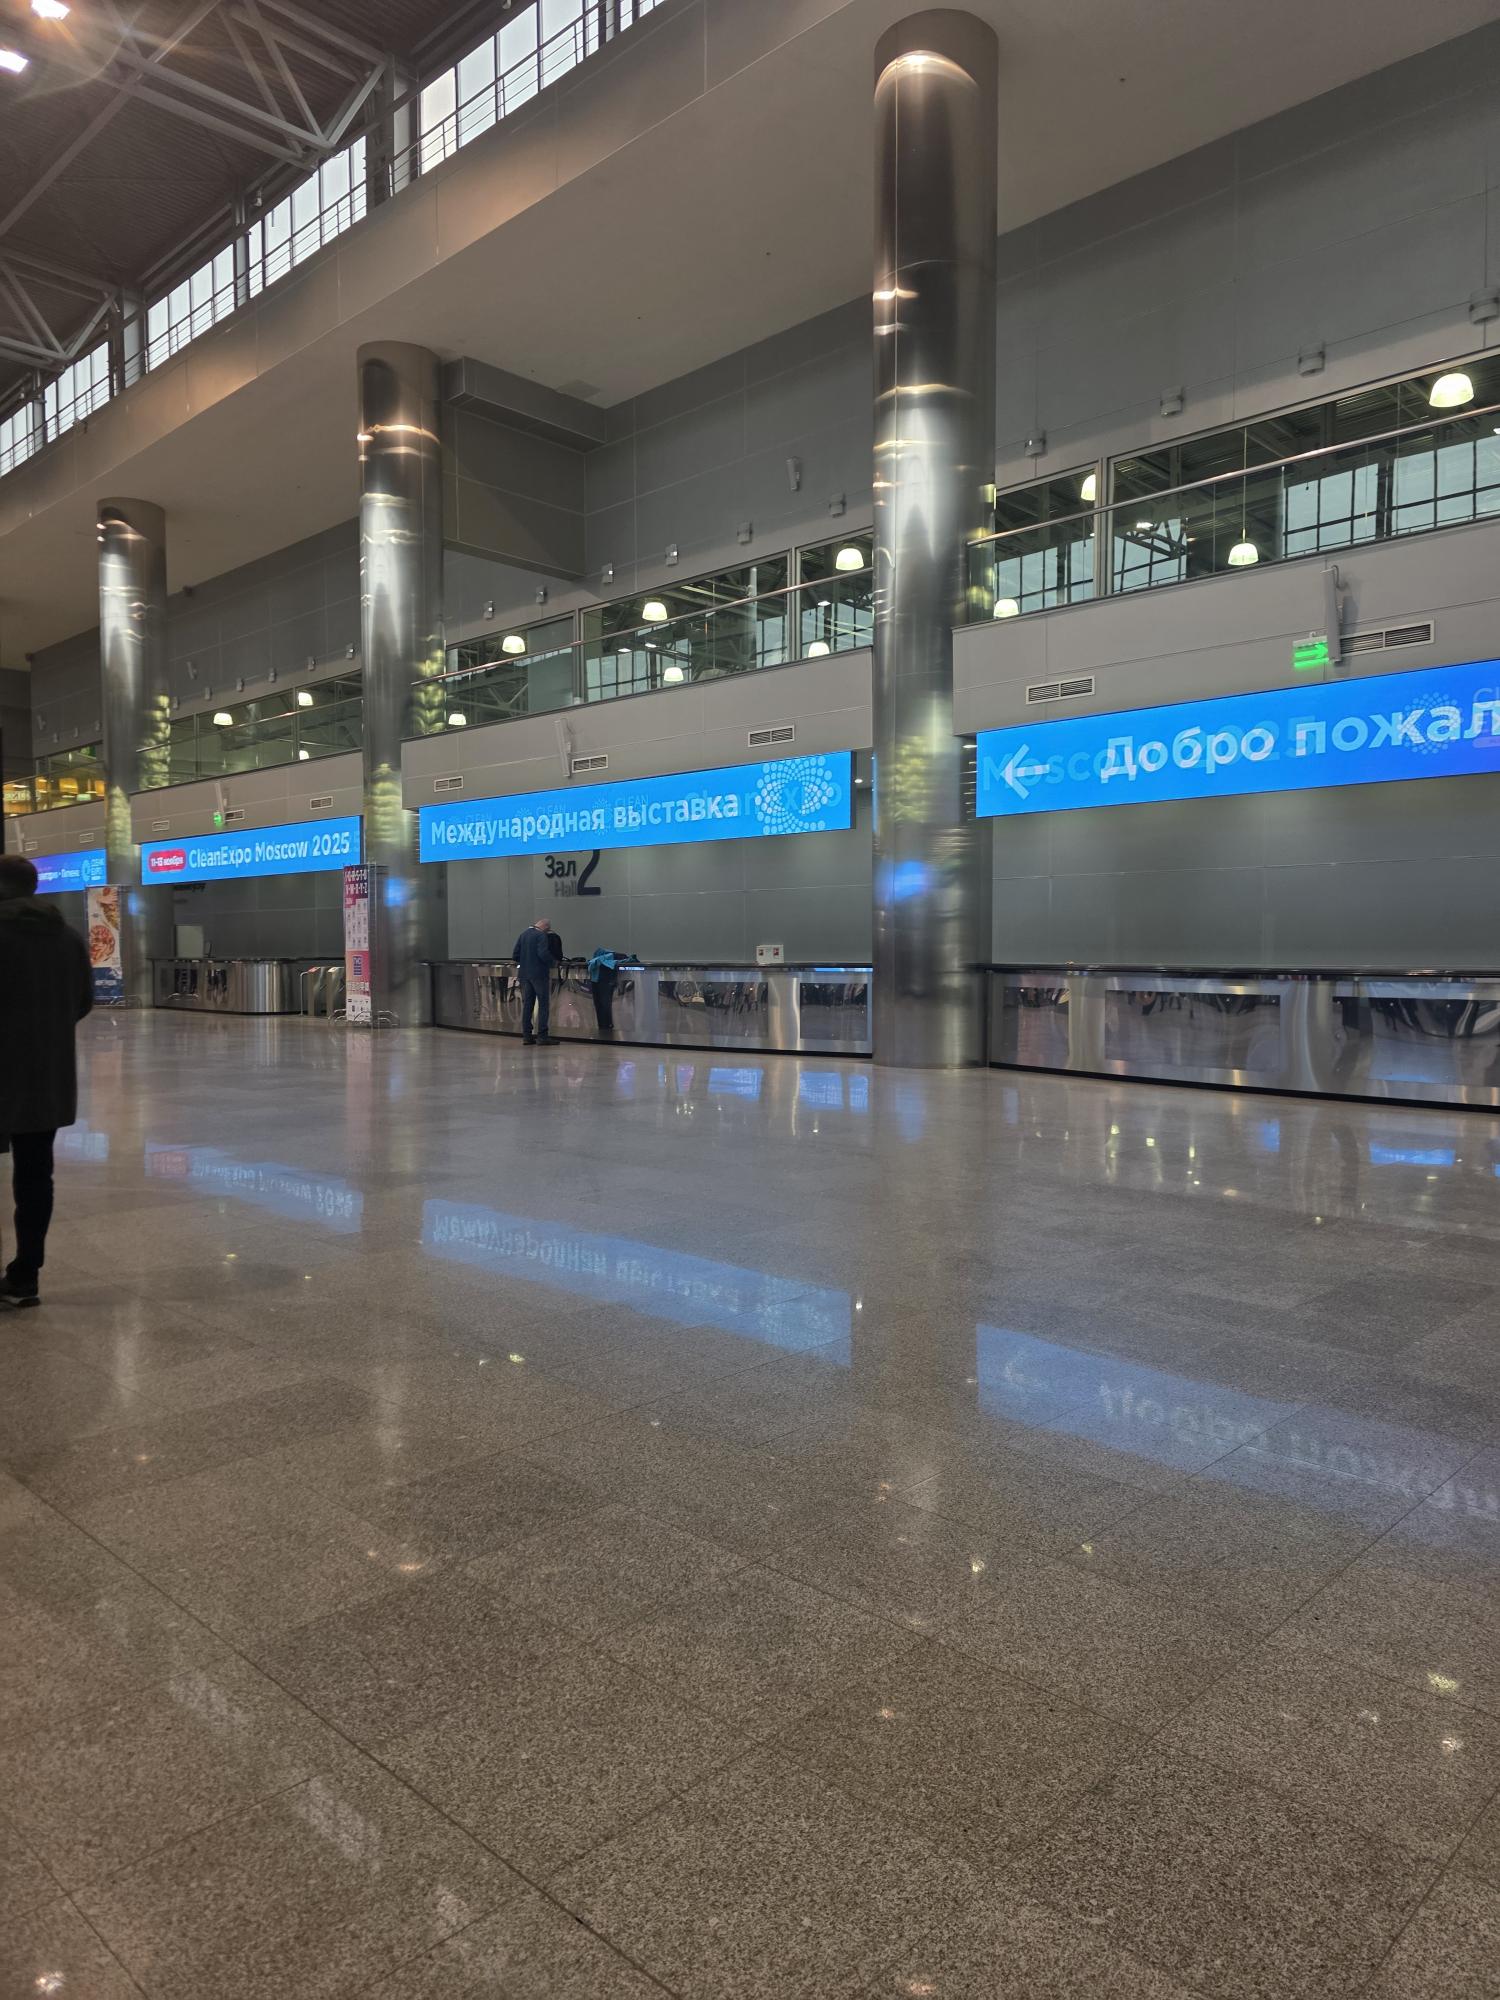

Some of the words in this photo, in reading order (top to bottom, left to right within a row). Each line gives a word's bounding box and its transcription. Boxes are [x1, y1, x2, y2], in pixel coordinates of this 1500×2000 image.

[1100, 726, 1275, 784] Добро
[431, 808, 605, 845] Международная
[613, 793, 739, 829] выставка
[188, 846, 252, 868] CleanExpo
[255, 841, 308, 862] Moscow
[312, 831, 350, 857] 2025
[544, 855, 577, 878] Зал
[577, 849, 601, 895] 2
